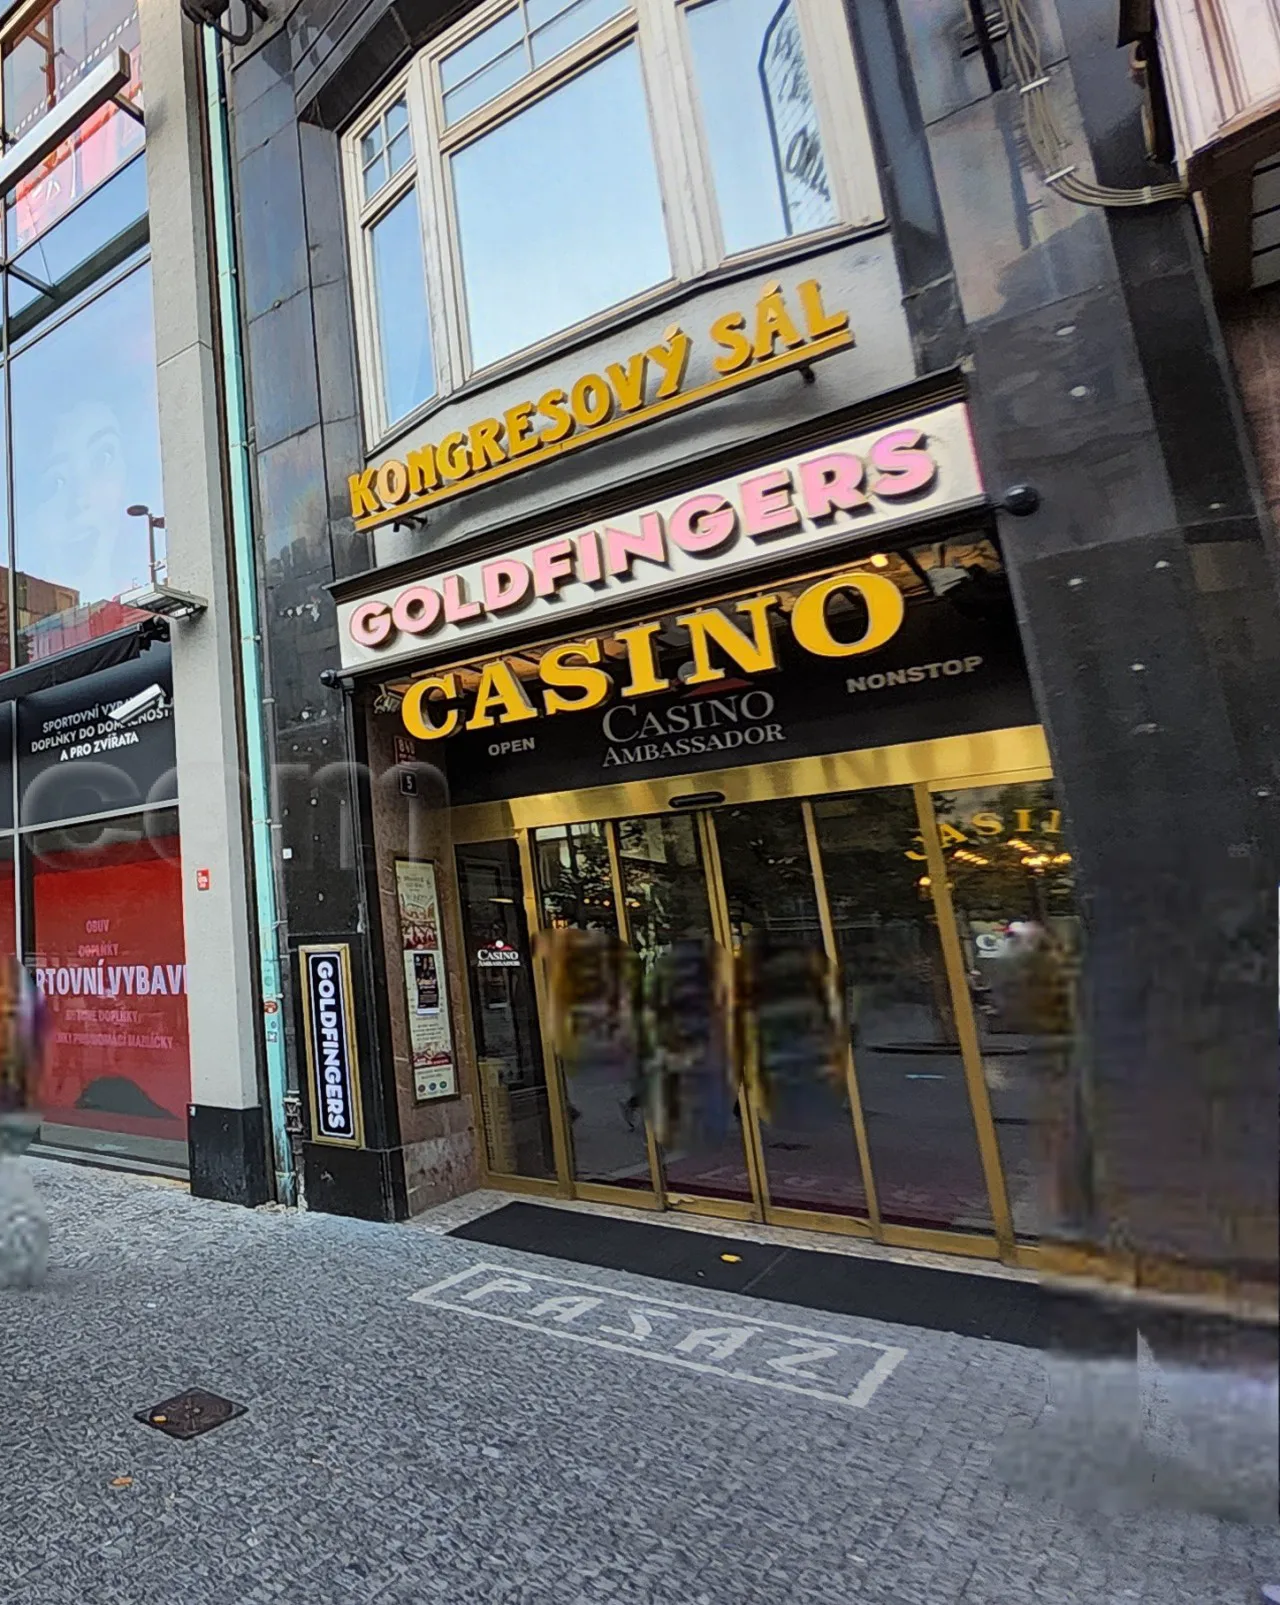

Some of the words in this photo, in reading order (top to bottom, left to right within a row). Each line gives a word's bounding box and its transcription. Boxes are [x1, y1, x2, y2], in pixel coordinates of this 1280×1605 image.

[348, 325, 693, 520] KONGRESOVÝ
[710, 279, 851, 376] SÁL
[348, 428, 940, 650] GOLDFINGERS
[402, 572, 905, 740] CASINO
[846, 655, 983, 693] NONSTOP
[42, 705, 99, 734] SPORTOVNÍ
[31, 728, 77, 752] DOPLŇKY
[78, 726, 96, 739] DO
[60, 750, 68, 762] A
[70, 744, 92, 760] PRO
[93, 731, 140, 753] ZVÍŘATA
[488, 736, 536, 758] OPEN
[602, 722, 787, 769] AMBASSADOR
[86, 920, 110, 934] OBUV
[78, 941, 120, 957] DOPLŇKY
[477, 949, 519, 961] CASINO
[317, 961, 345, 1129] GOLDFINGERS
